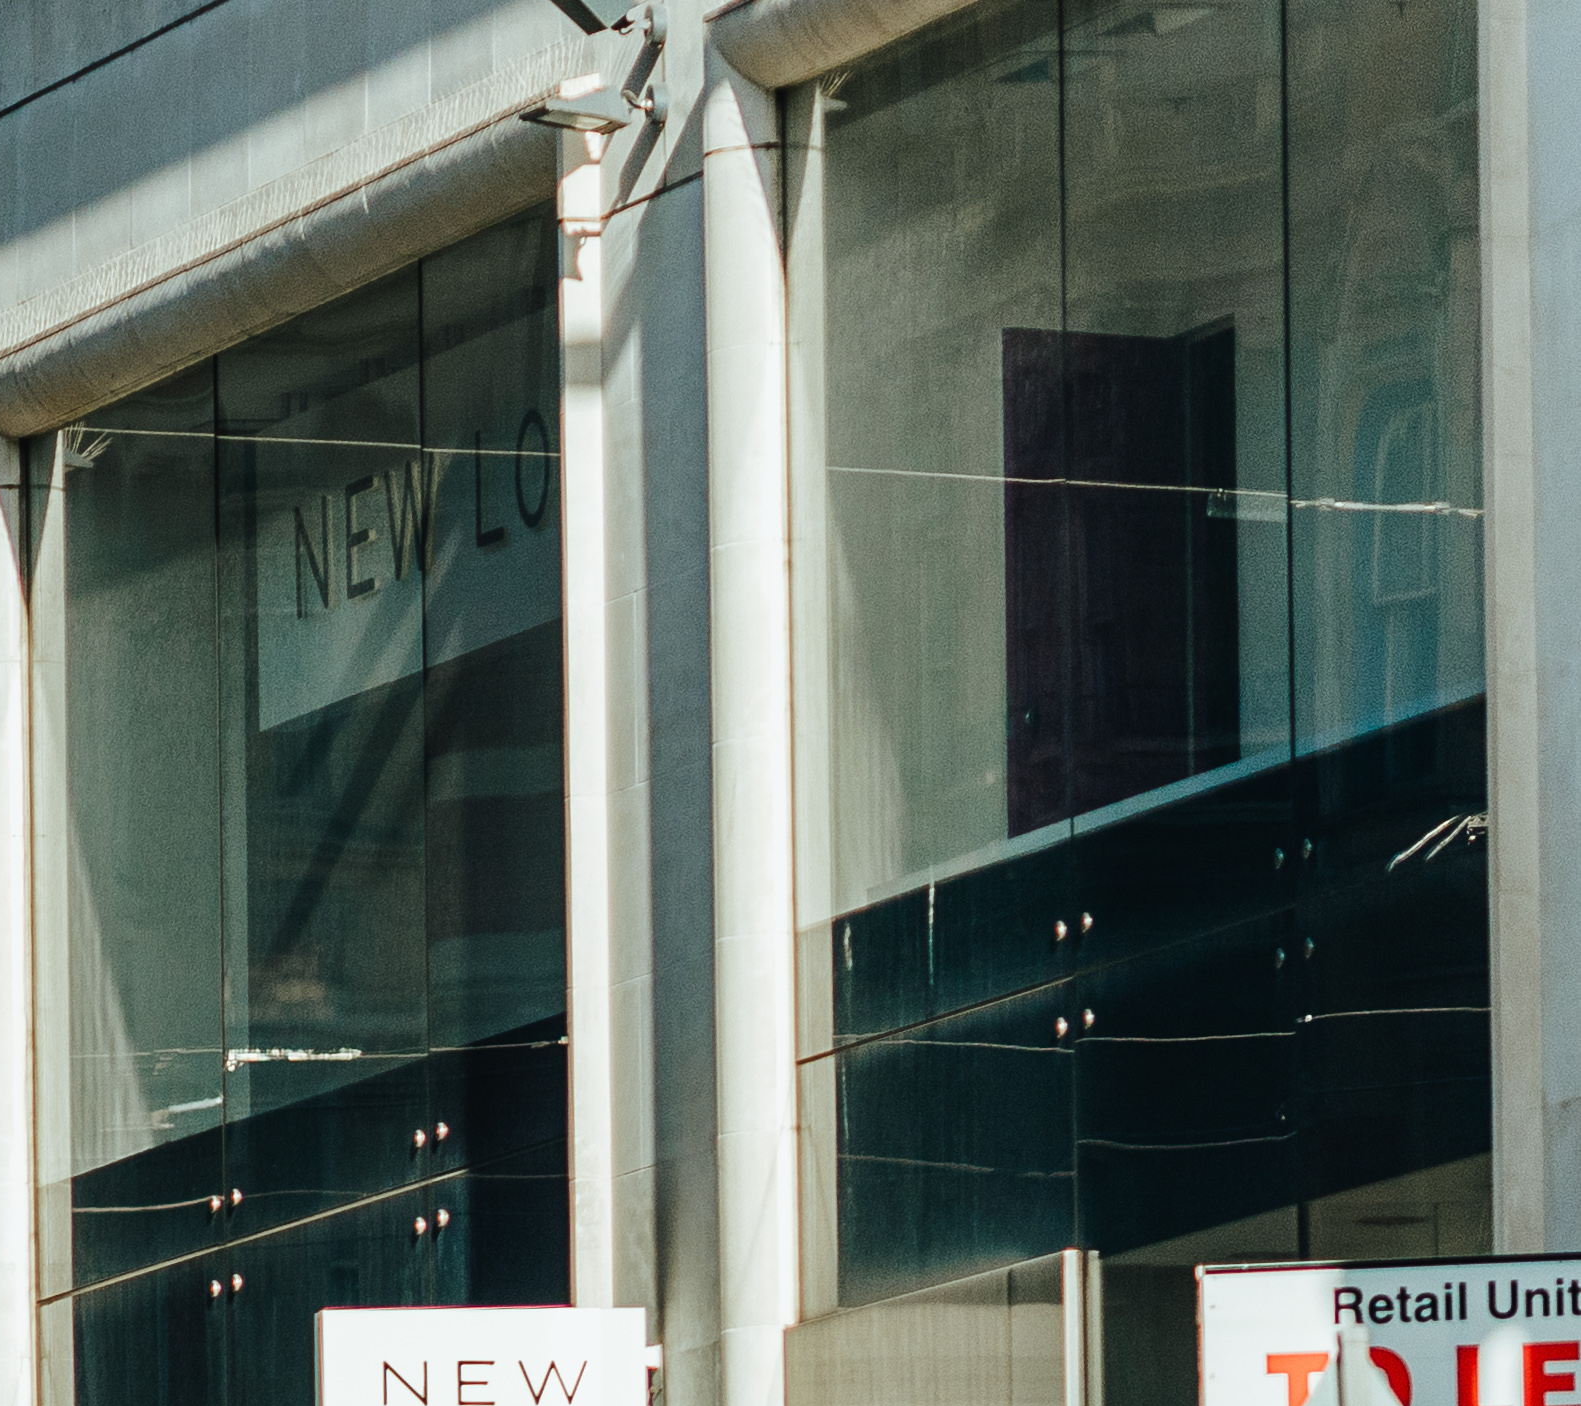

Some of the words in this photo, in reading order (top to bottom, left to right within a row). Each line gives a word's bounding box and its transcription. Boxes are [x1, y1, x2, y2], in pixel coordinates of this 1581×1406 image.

[293, 453, 440, 620] NEW
[1334, 1281, 1467, 1324] Retail
[382, 1360, 588, 1406] NEW
